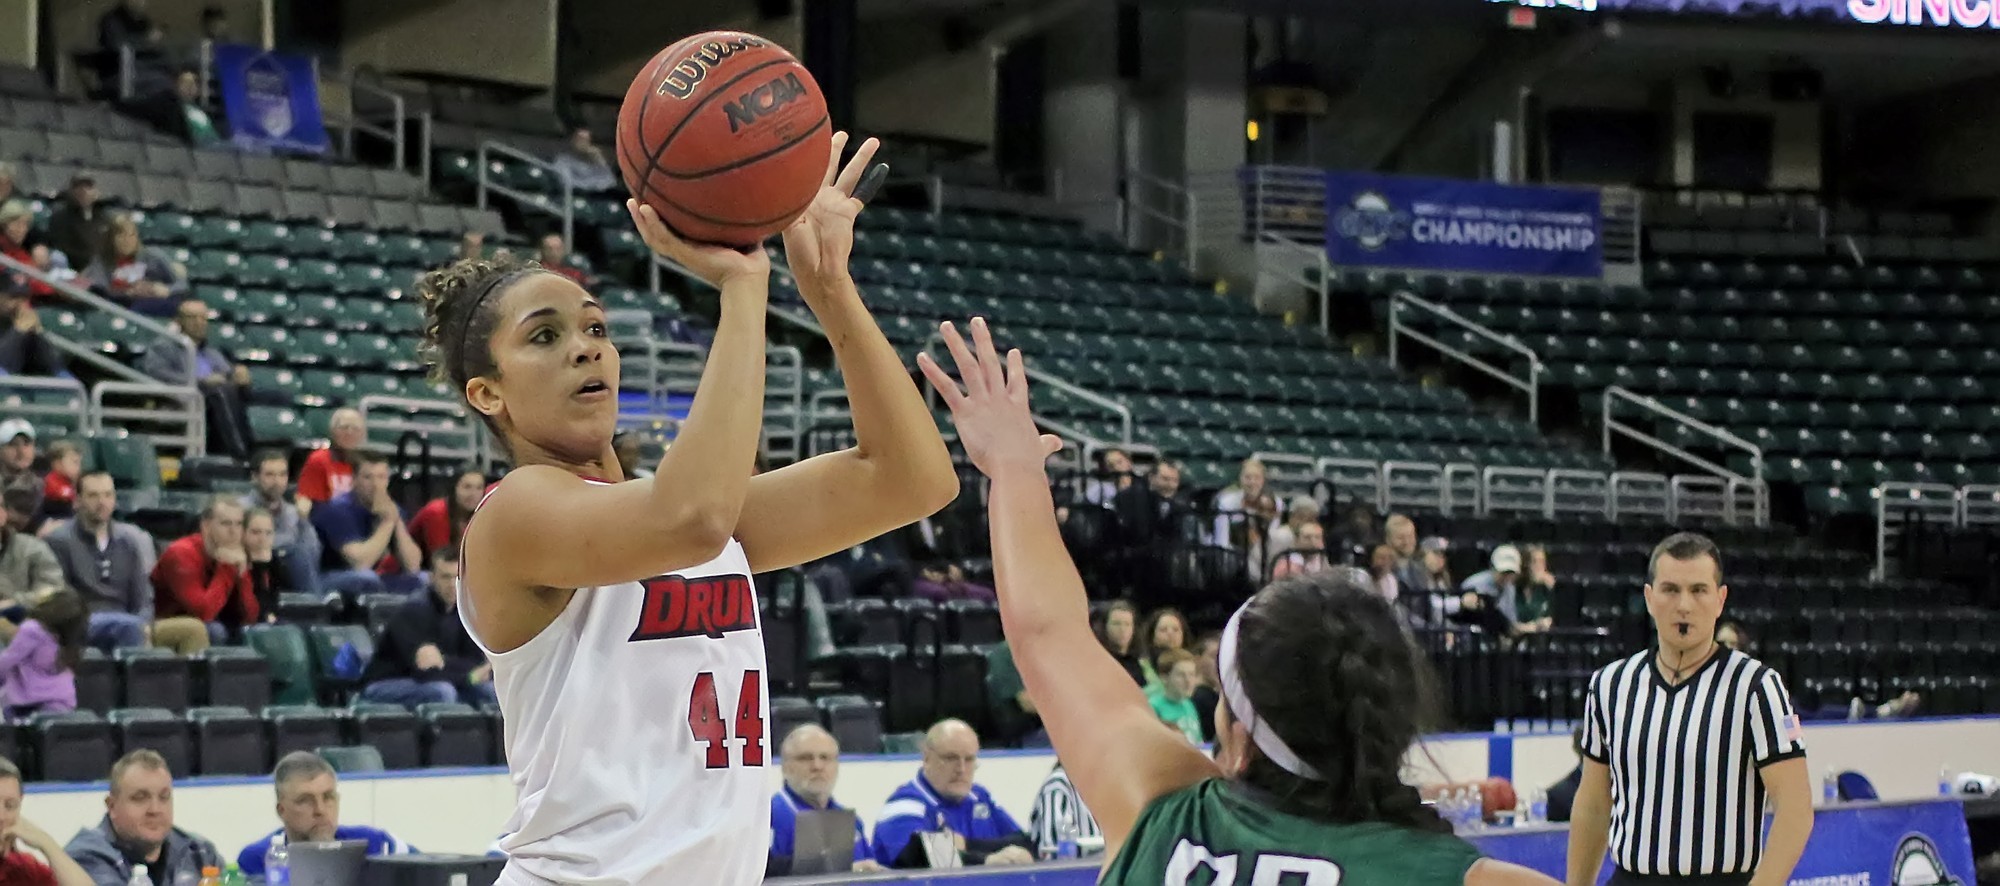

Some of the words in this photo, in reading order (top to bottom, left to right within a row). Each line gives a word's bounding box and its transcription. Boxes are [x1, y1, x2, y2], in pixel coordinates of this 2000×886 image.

[722, 71, 807, 133] NCAA
[1412, 217, 1595, 252] CHAMPIONSHIP
[687, 669, 764, 769] 44
